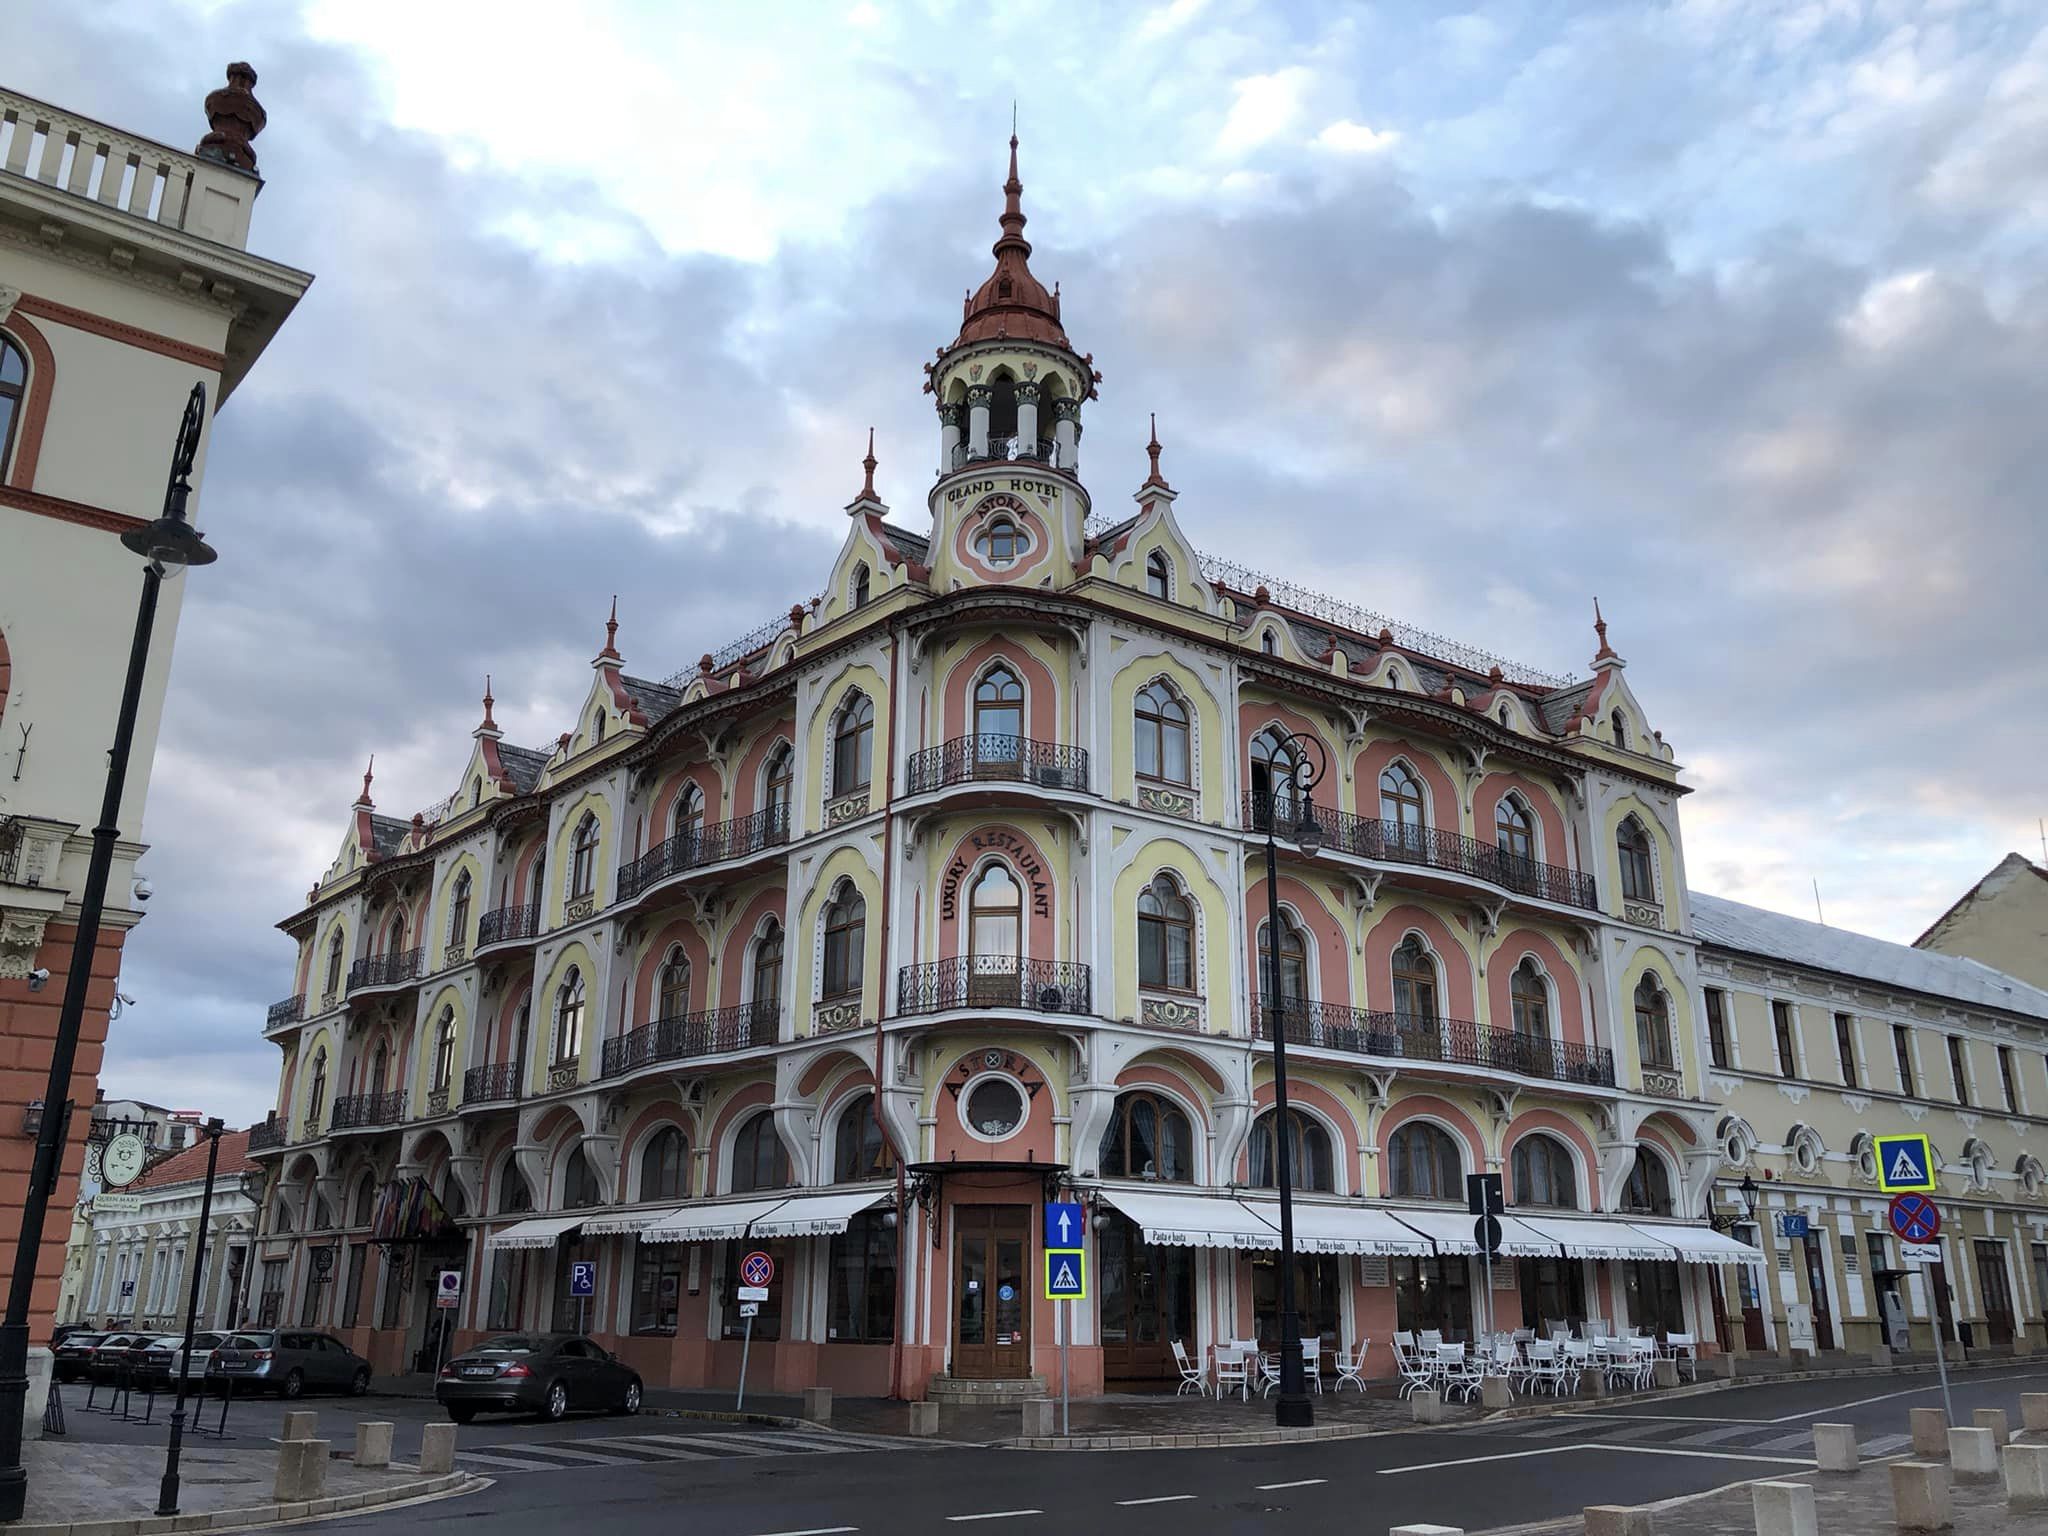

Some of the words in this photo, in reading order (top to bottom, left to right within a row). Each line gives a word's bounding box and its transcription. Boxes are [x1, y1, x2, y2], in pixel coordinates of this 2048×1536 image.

[948, 480, 995, 502] GRAND
[1010, 479, 1058, 498] HOTEL
[977, 496, 1029, 519] ASTORIA
[943, 856, 968, 921] LUXURY
[971, 832, 1049, 919] RESTAURANT
[1153, 1230, 1167, 1241] Pasta
[574, 1265, 587, 1283] P
